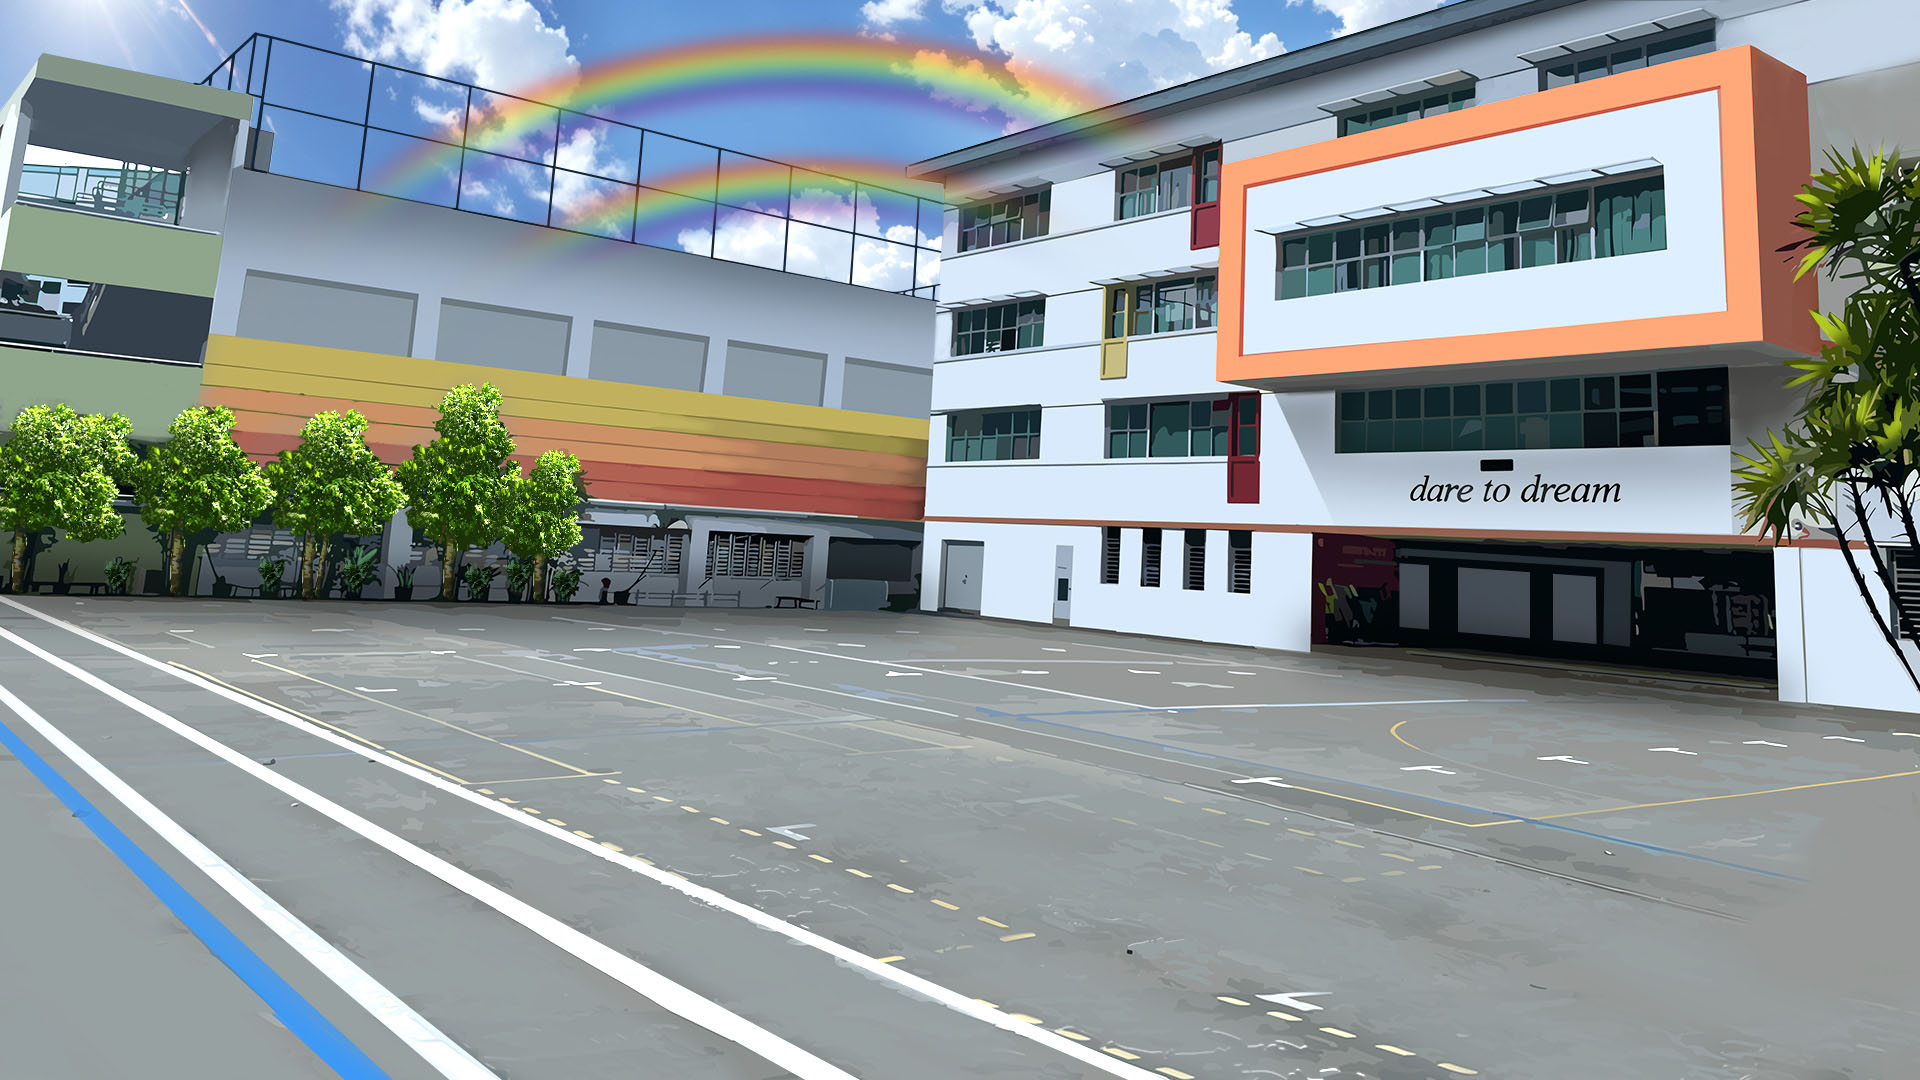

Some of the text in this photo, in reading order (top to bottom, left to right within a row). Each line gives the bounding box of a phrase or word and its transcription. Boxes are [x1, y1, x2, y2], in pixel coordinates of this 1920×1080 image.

[1410, 474, 1621, 503] dare to dream
